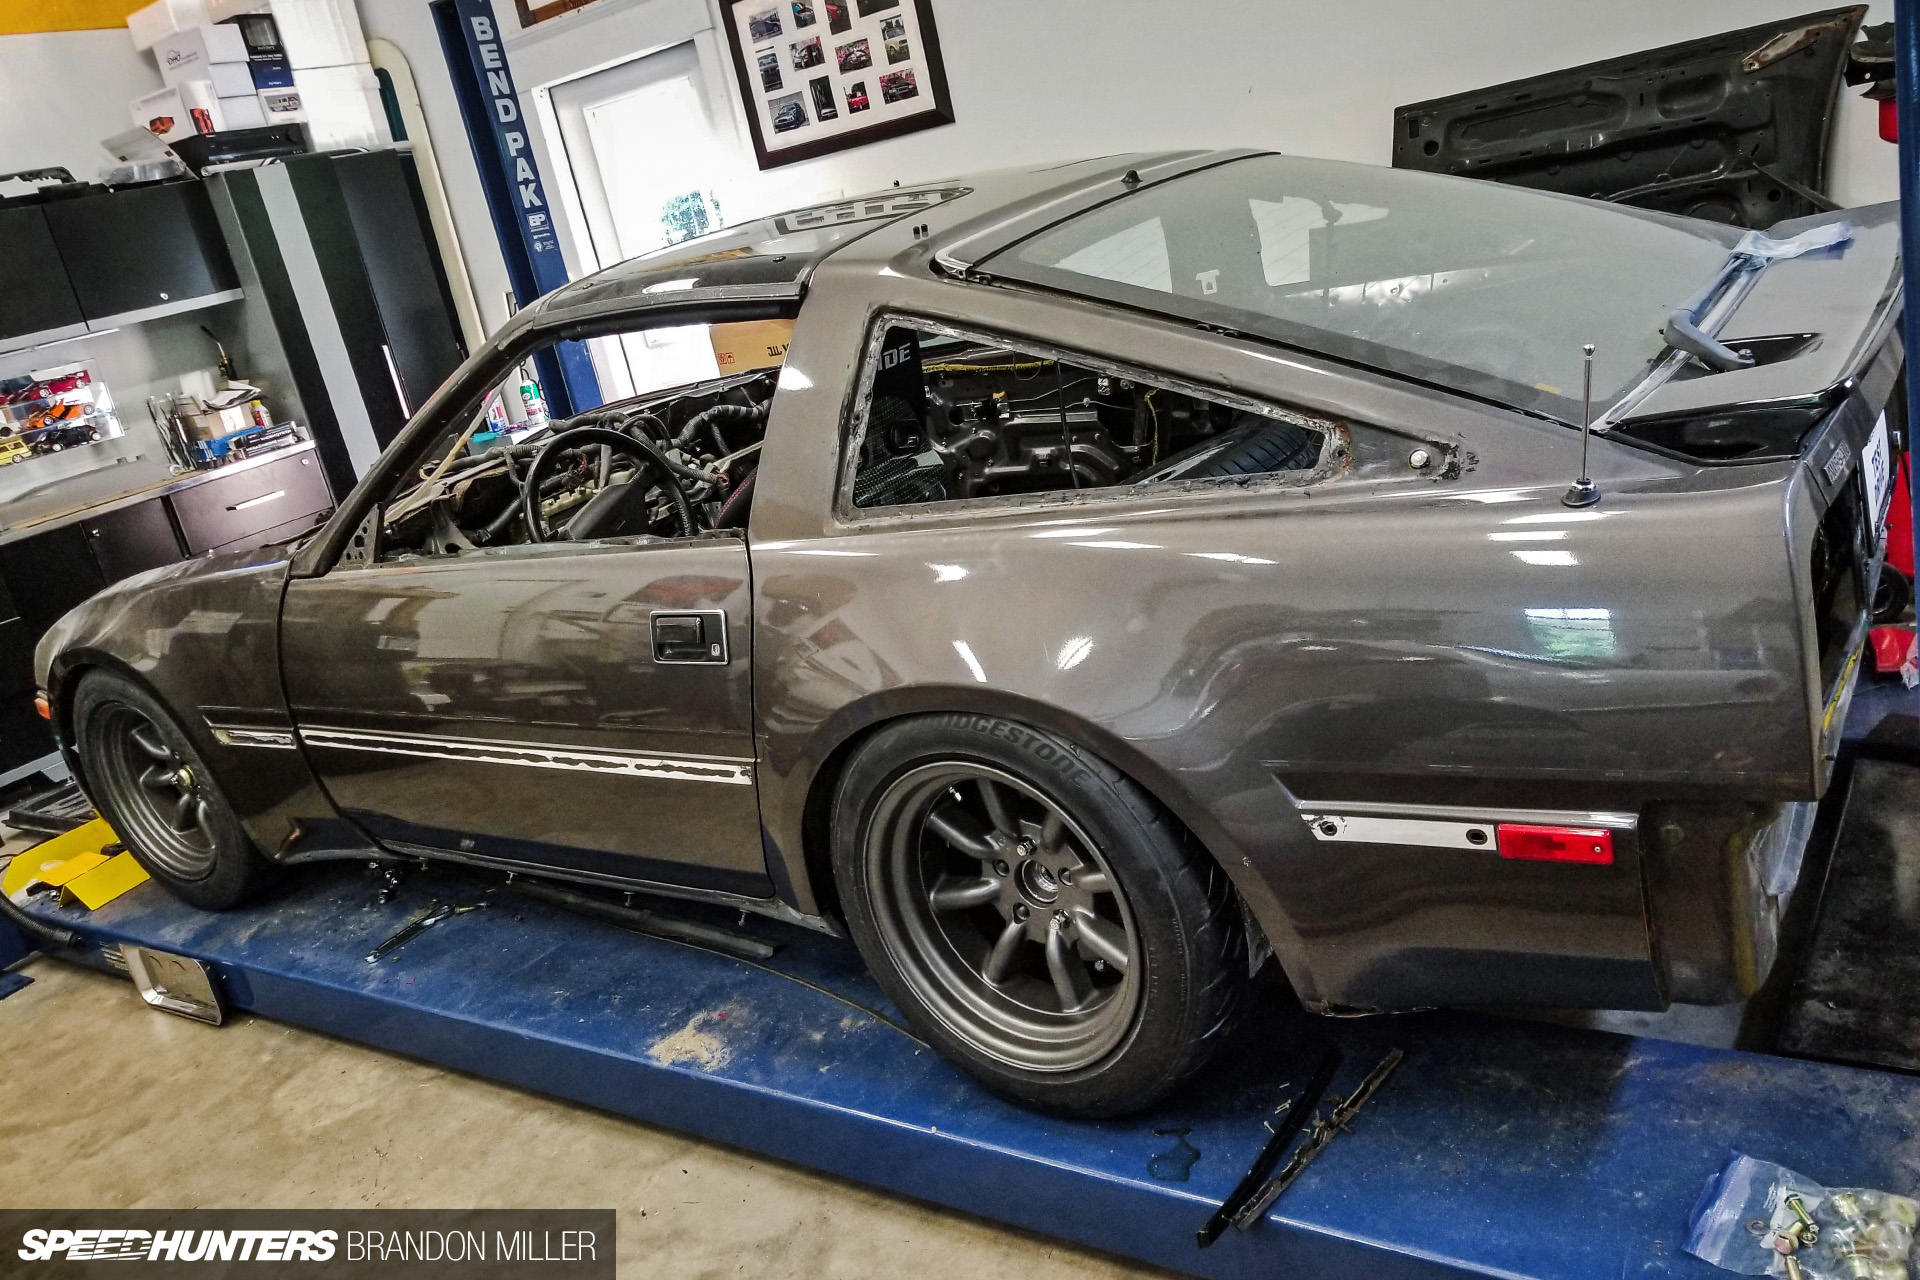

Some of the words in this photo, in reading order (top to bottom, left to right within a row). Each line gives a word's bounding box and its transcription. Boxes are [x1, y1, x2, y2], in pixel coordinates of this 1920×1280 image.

[471, 16, 517, 123] BEND
[505, 132, 543, 208] PAK
[877, 342, 911, 371] IDE
[1872, 438, 1881, 478] TEST
